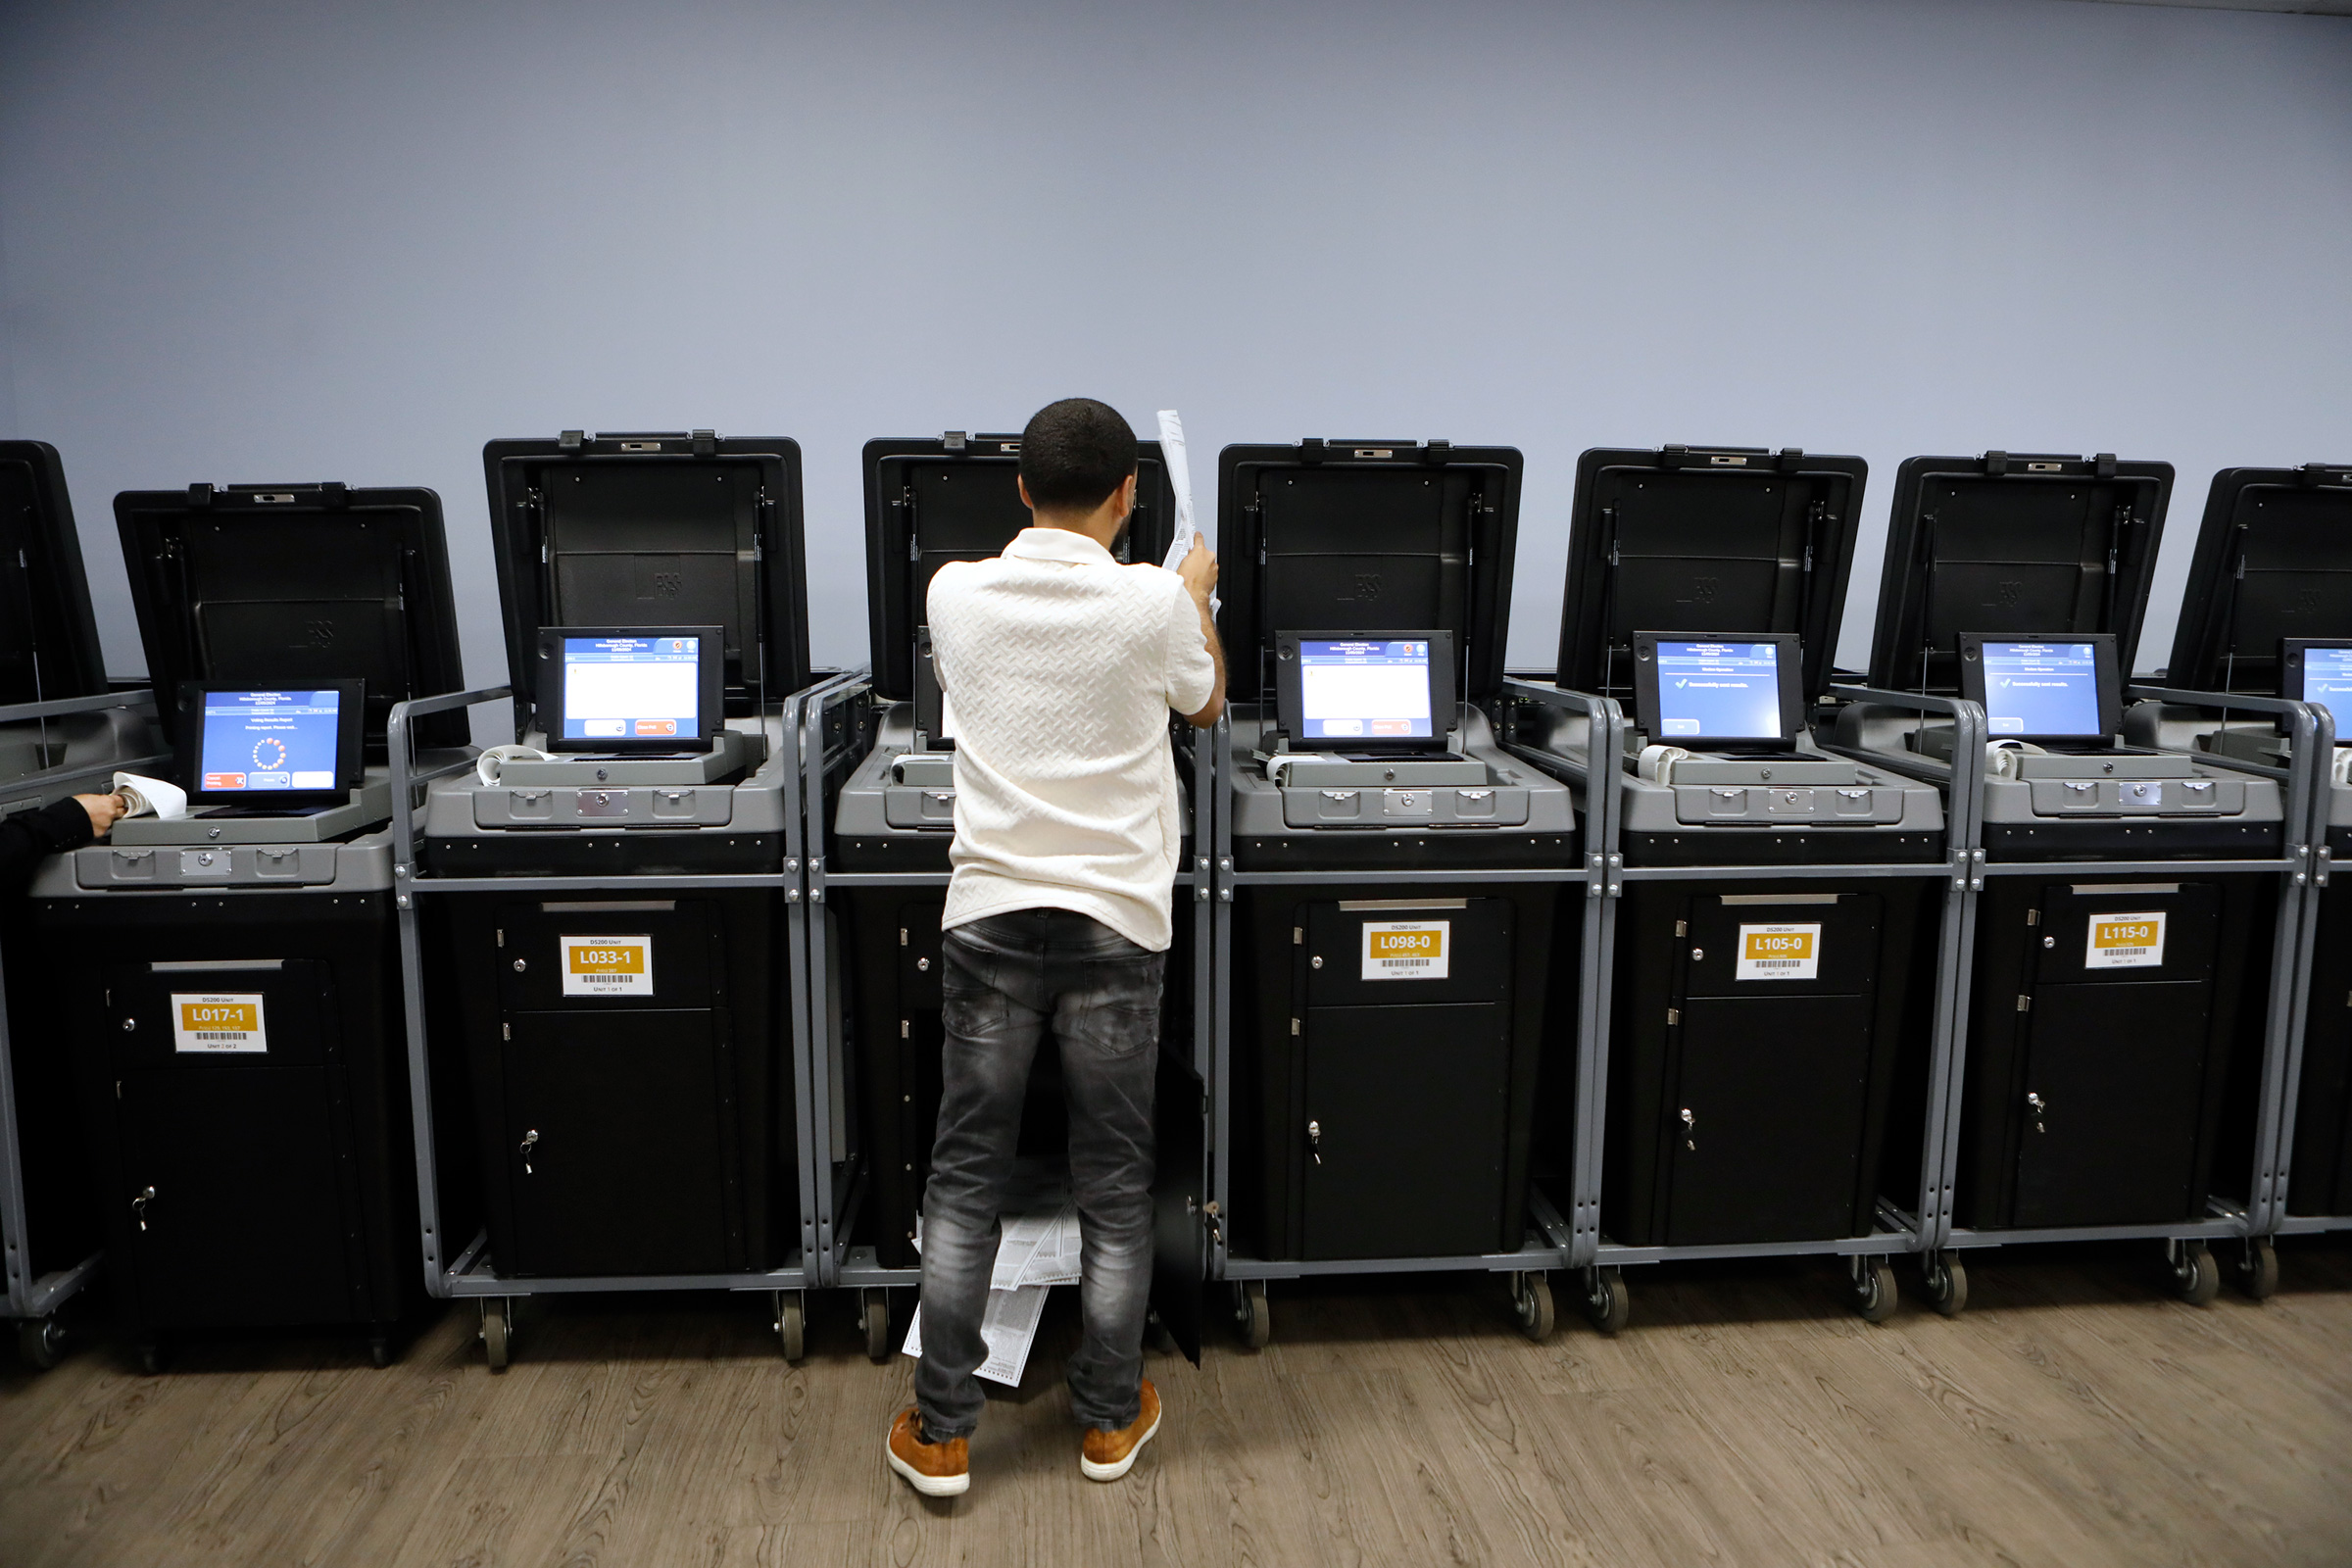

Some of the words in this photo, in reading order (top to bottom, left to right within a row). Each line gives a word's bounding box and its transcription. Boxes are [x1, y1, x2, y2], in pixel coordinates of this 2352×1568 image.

[2103, 925, 2149, 939] L115-0
[1380, 935, 1431, 949] L098-0
[1755, 937, 1802, 951] L105-0
[580, 951, 631, 964] L033-1
[192, 1008, 244, 1021] L017-1
